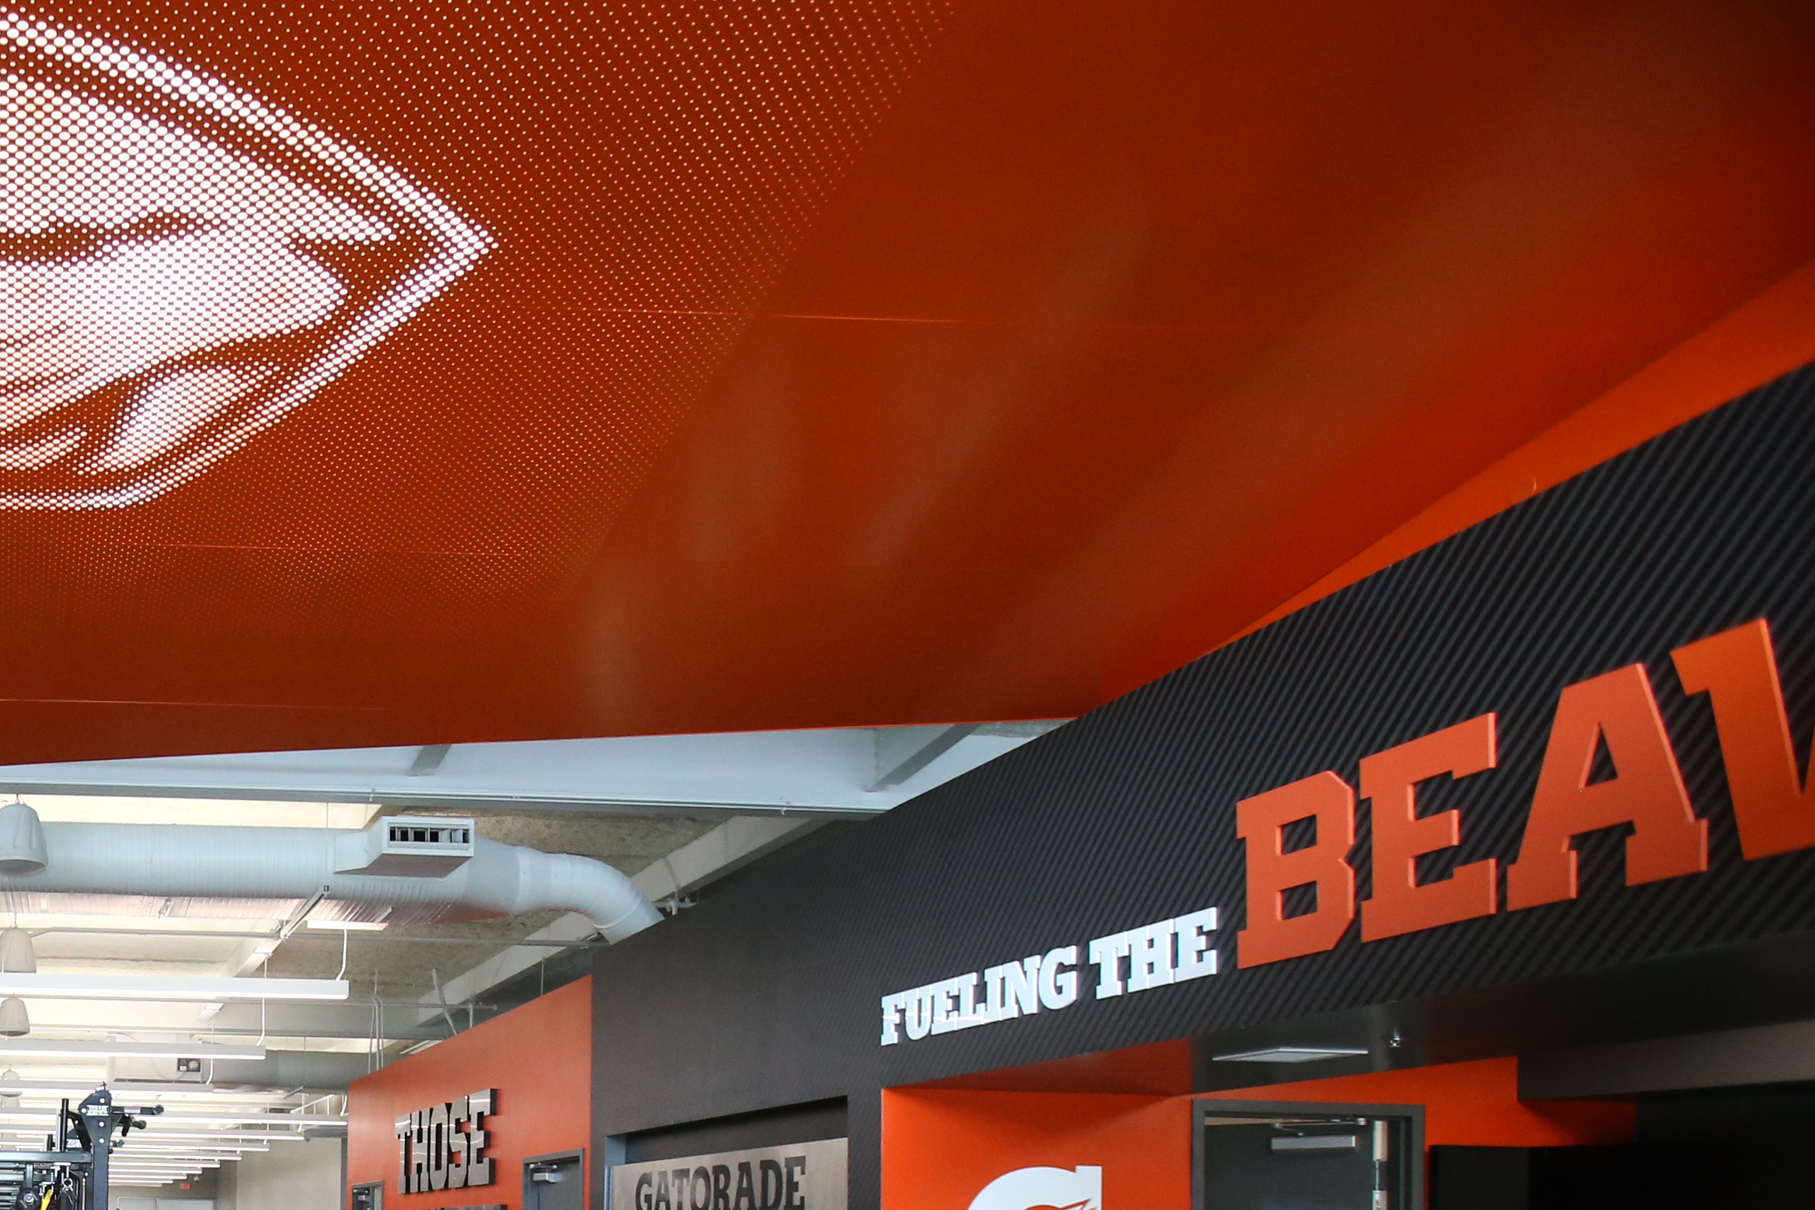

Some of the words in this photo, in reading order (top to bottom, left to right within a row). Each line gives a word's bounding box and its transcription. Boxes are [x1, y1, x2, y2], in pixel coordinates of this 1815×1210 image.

[880, 945, 1078, 1046] FUELING
[1089, 906, 1217, 1000] THE
[395, 1088, 497, 1194] THOSE
